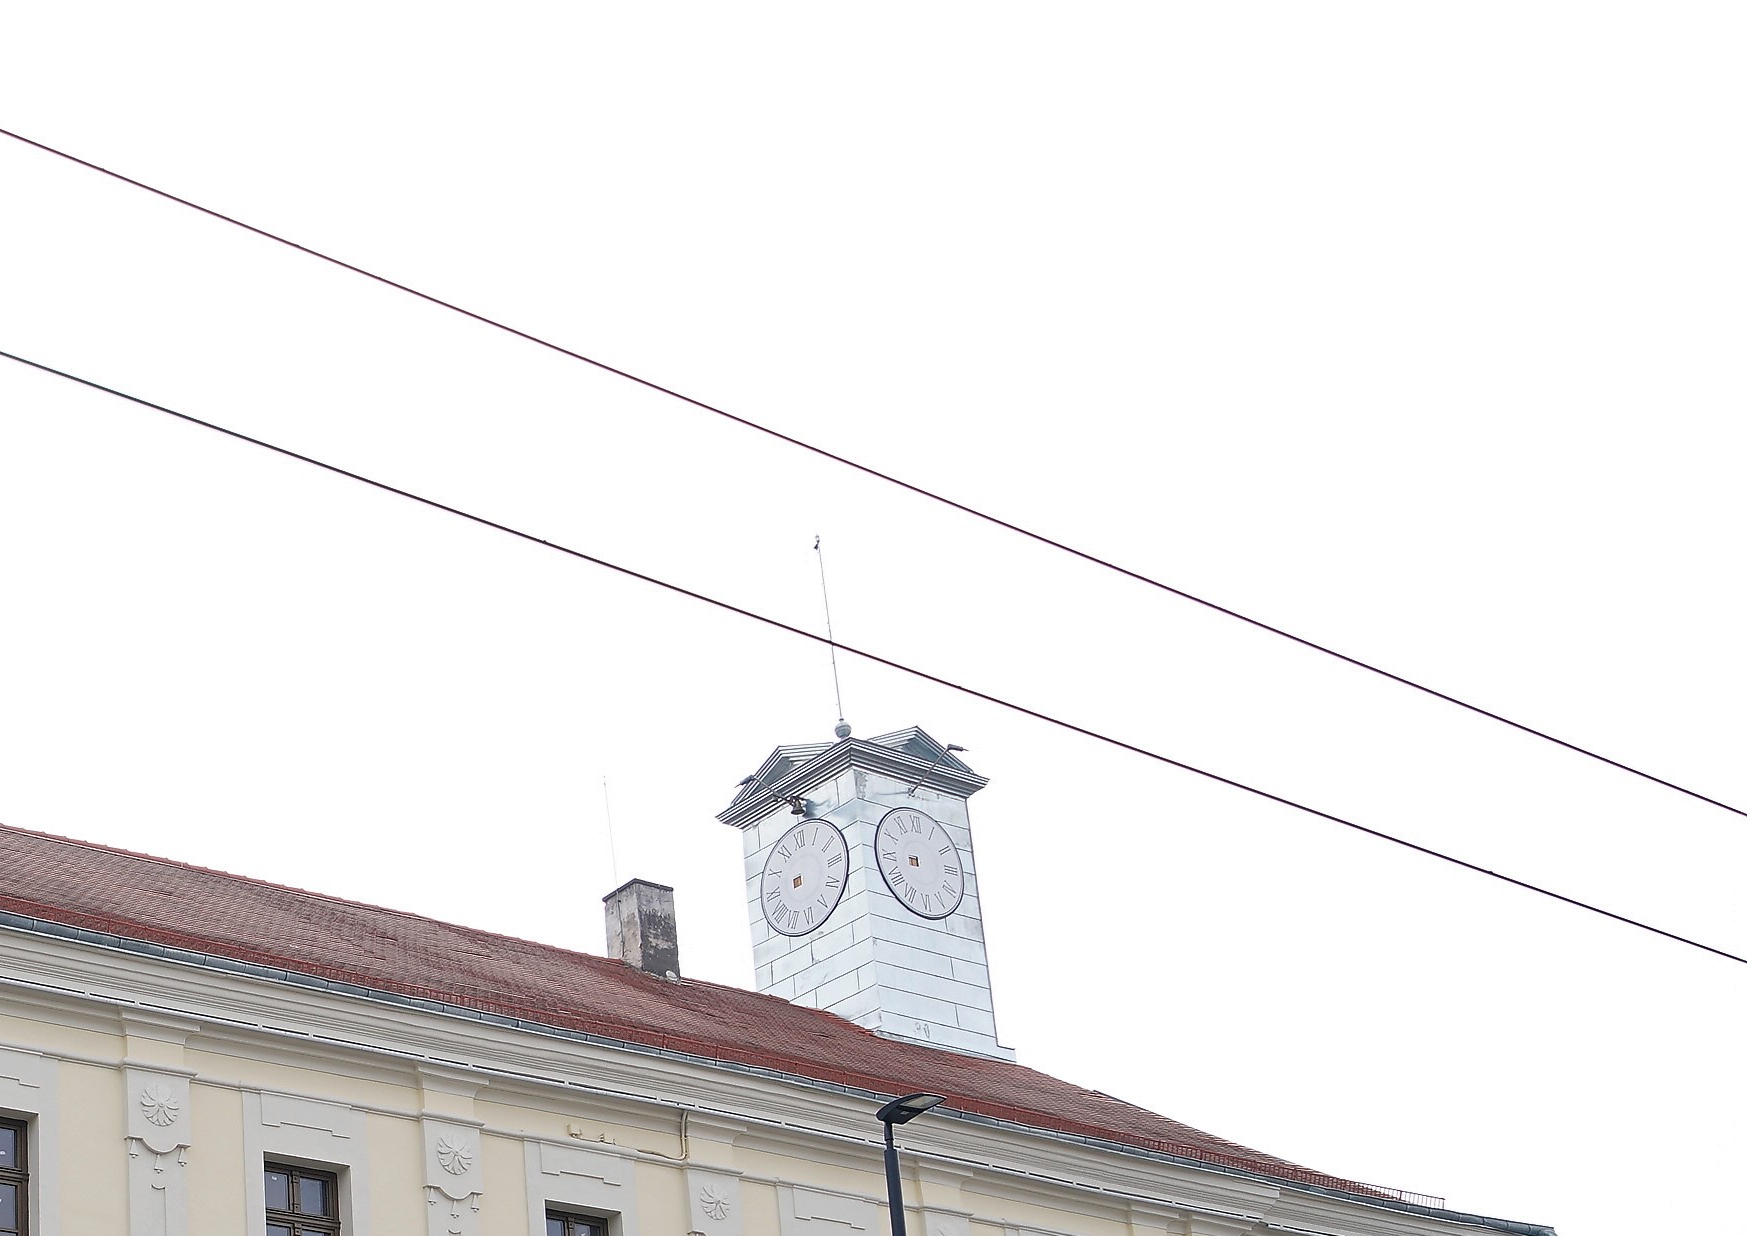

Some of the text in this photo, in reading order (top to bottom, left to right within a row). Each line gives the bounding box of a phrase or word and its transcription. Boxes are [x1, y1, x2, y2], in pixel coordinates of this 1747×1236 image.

[894, 816, 907, 835] XI
[910, 815, 921, 834] XII
[793, 830, 805, 851] XII
[812, 828, 818, 846] I
[884, 829, 898, 844] X
[929, 827, 934, 840] I
[822, 836, 834, 853] II
[939, 846, 951, 855] II
[778, 845, 792, 863] XI
[827, 853, 842, 868] III
[882, 849, 897, 861] IX
[768, 869, 782, 878] X
[889, 866, 905, 886] VIII
[944, 865, 958, 876] III
[826, 876, 840, 888] IV
[942, 880, 956, 898] IV
[766, 887, 780, 902] IX
[817, 894, 828, 908] V
[904, 883, 916, 903] VII
[934, 892, 945, 909] V
[921, 893, 931, 912] VI
[772, 900, 789, 924] VIII
[787, 910, 799, 929] VII
[803, 907, 813, 925] VI
